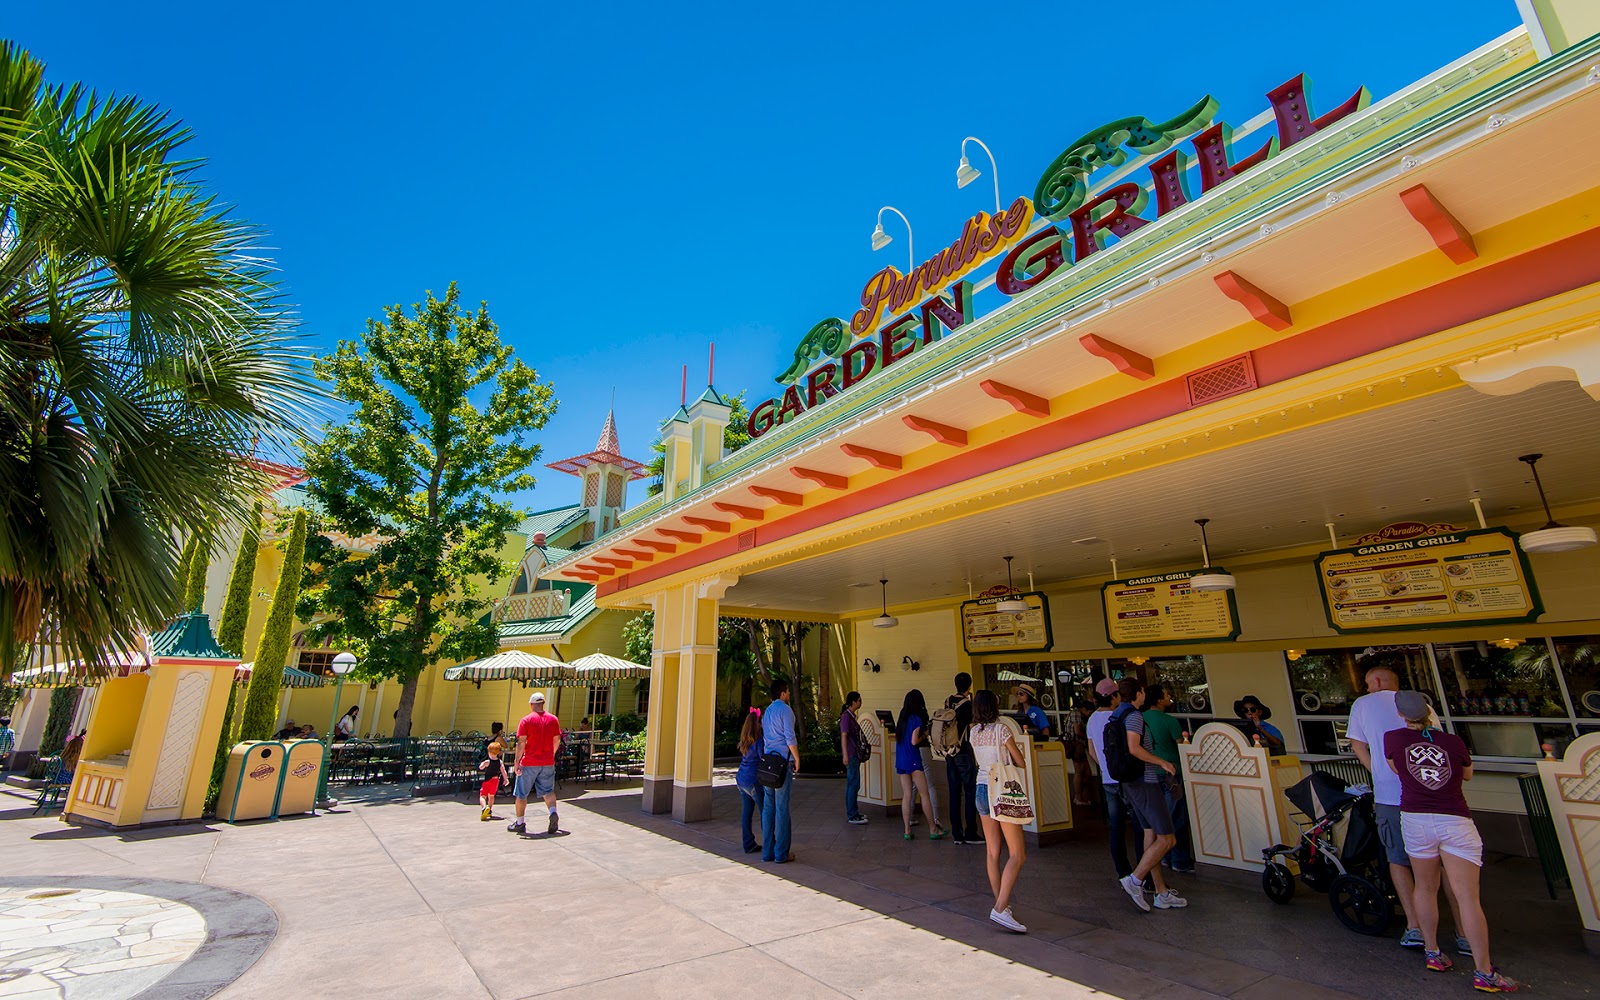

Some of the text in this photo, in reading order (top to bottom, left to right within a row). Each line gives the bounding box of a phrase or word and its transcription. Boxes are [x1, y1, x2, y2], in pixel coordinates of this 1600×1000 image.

[748, 72, 1371, 438] GARDEN GRILL
[850, 196, 1034, 338] Paradise
[1382, 525, 1424, 538] Paradise
[1358, 535, 1459, 555] GARDEN GRILL
[1128, 572, 1191, 585] GARDEN GRILL
[1421, 768, 1441, 782] R
